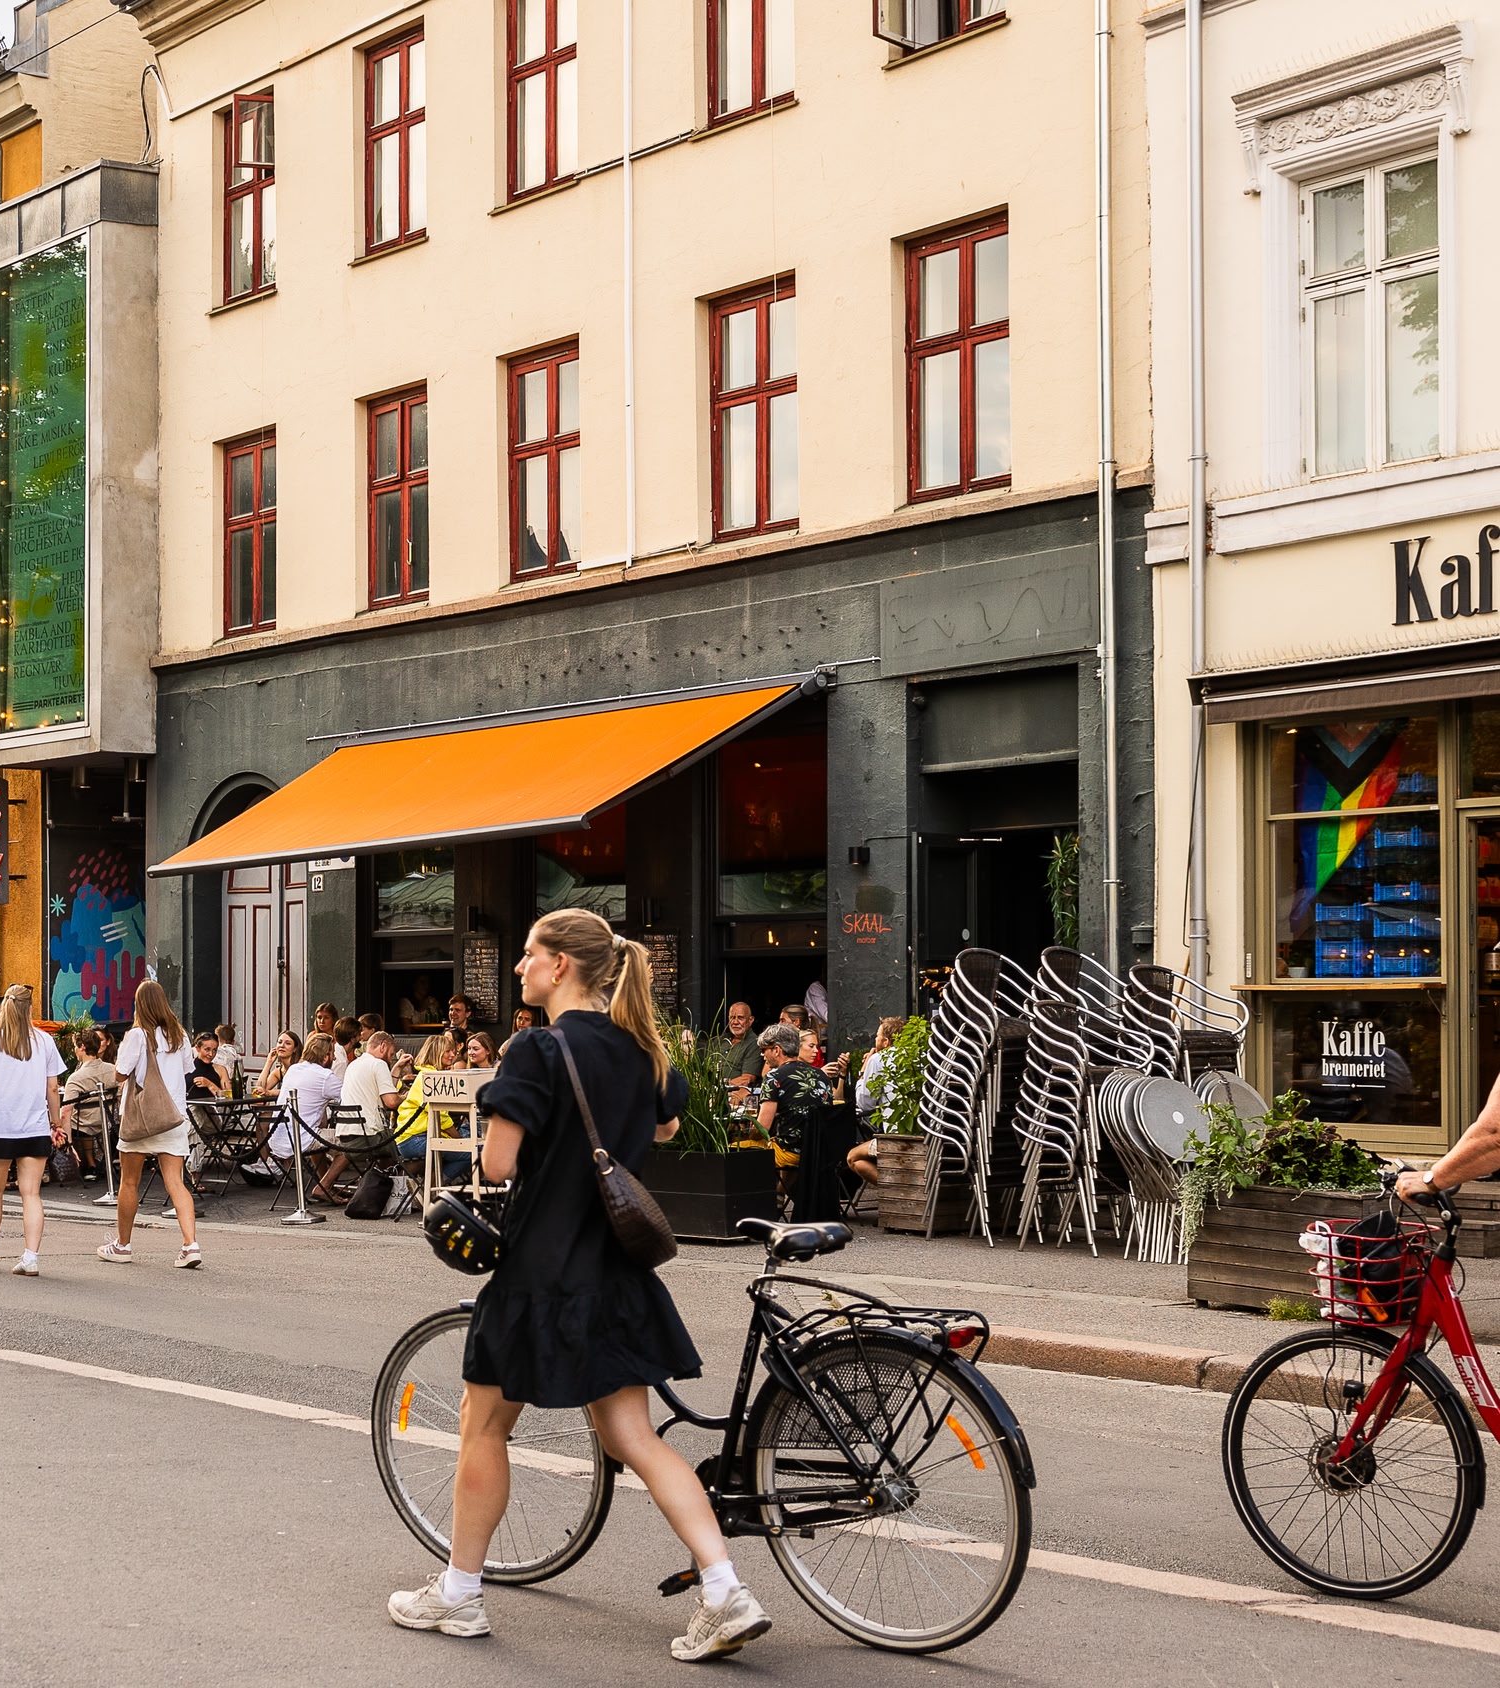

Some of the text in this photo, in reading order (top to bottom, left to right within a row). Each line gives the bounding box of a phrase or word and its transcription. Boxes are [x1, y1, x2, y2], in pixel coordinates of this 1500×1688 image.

[15, 434, 38, 452] IKKE
[14, 500, 51, 521] IN VAIN
[14, 526, 34, 542] THE
[38, 513, 83, 537] FEELGOOD
[14, 531, 72, 556] ORCHESTRA
[19, 555, 50, 573] FIGHT
[51, 549, 69, 567] THE
[14, 628, 48, 643] EMBLA
[50, 621, 71, 636] AND
[14, 659, 62, 680] REGNVÆR
[34, 694, 81, 710] PARKTEATRET
[313, 876, 322, 890] 12
[841, 912, 893, 935] SKAAL
[1321, 1020, 1386, 1058] Kaffe
[1321, 1058, 1386, 1078] brenneriet
[422, 1076, 468, 1098] SKAAL
